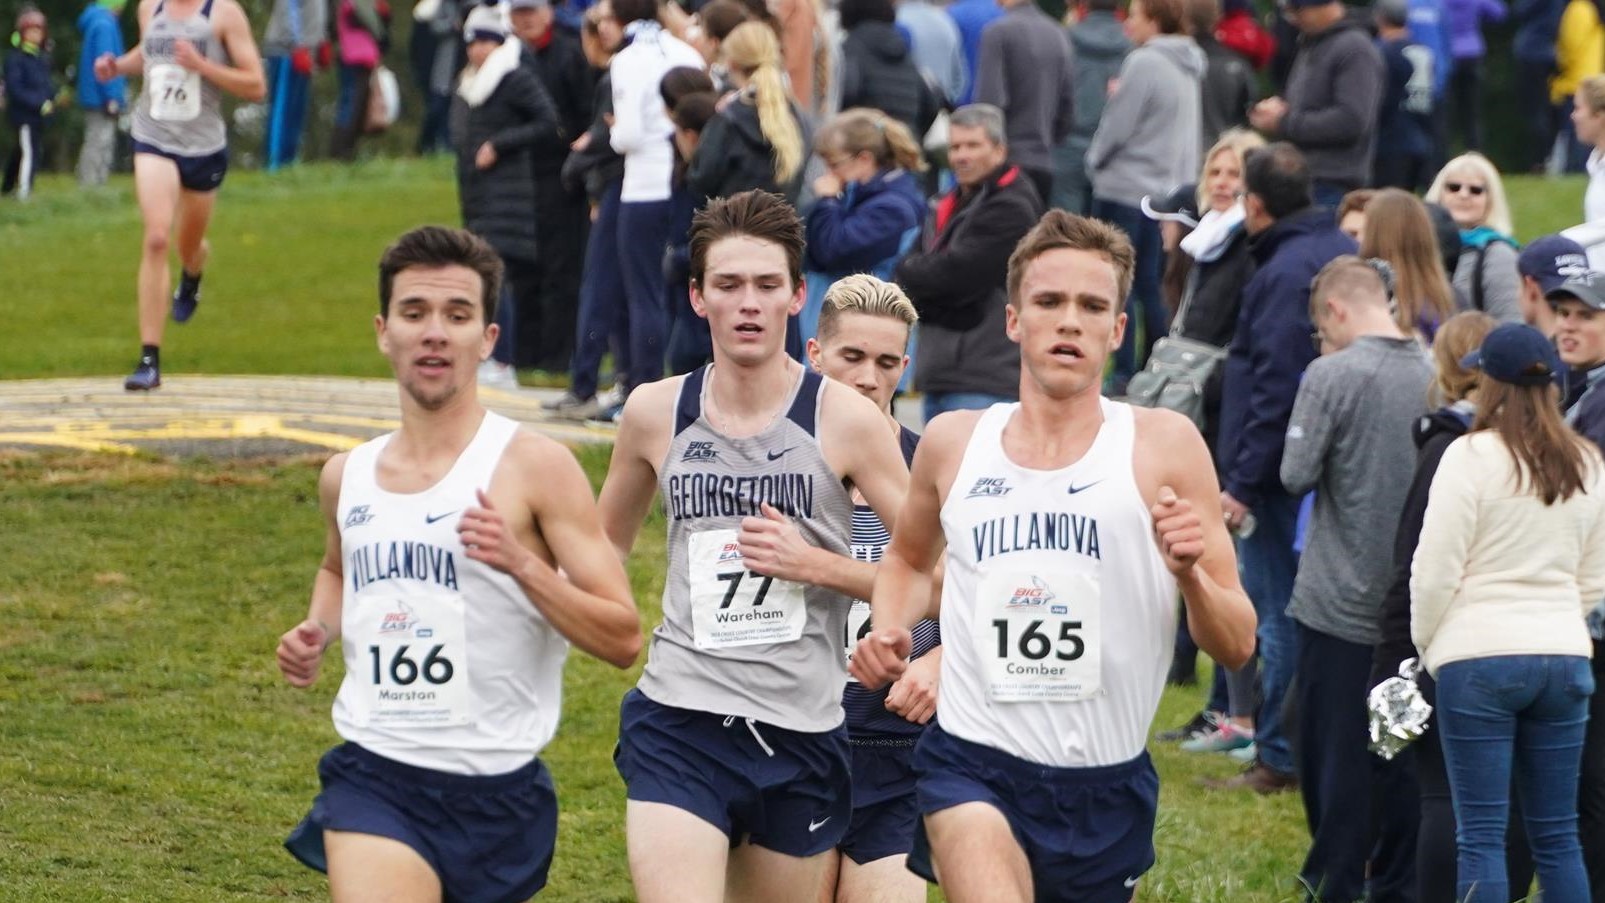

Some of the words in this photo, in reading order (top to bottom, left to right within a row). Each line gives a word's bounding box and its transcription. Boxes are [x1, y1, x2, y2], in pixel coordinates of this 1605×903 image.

[687, 441, 714, 449] BIG
[683, 450, 720, 458] EAST
[977, 478, 1007, 486] BIG
[669, 473, 813, 520] GEORGETOWN
[968, 486, 1013, 495] EAST
[972, 512, 1101, 563] VILLANOVA
[350, 541, 459, 592] VILLANOVA
[717, 571, 774, 609] 77
[1015, 588, 1044, 596] BIG
[1010, 597, 1049, 605] EAST
[716, 609, 784, 623] Wareham
[992, 619, 1085, 661] 165
[369, 644, 454, 685] 166
[1007, 662, 1066, 675] Comber
[379, 690, 436, 700] Marston
